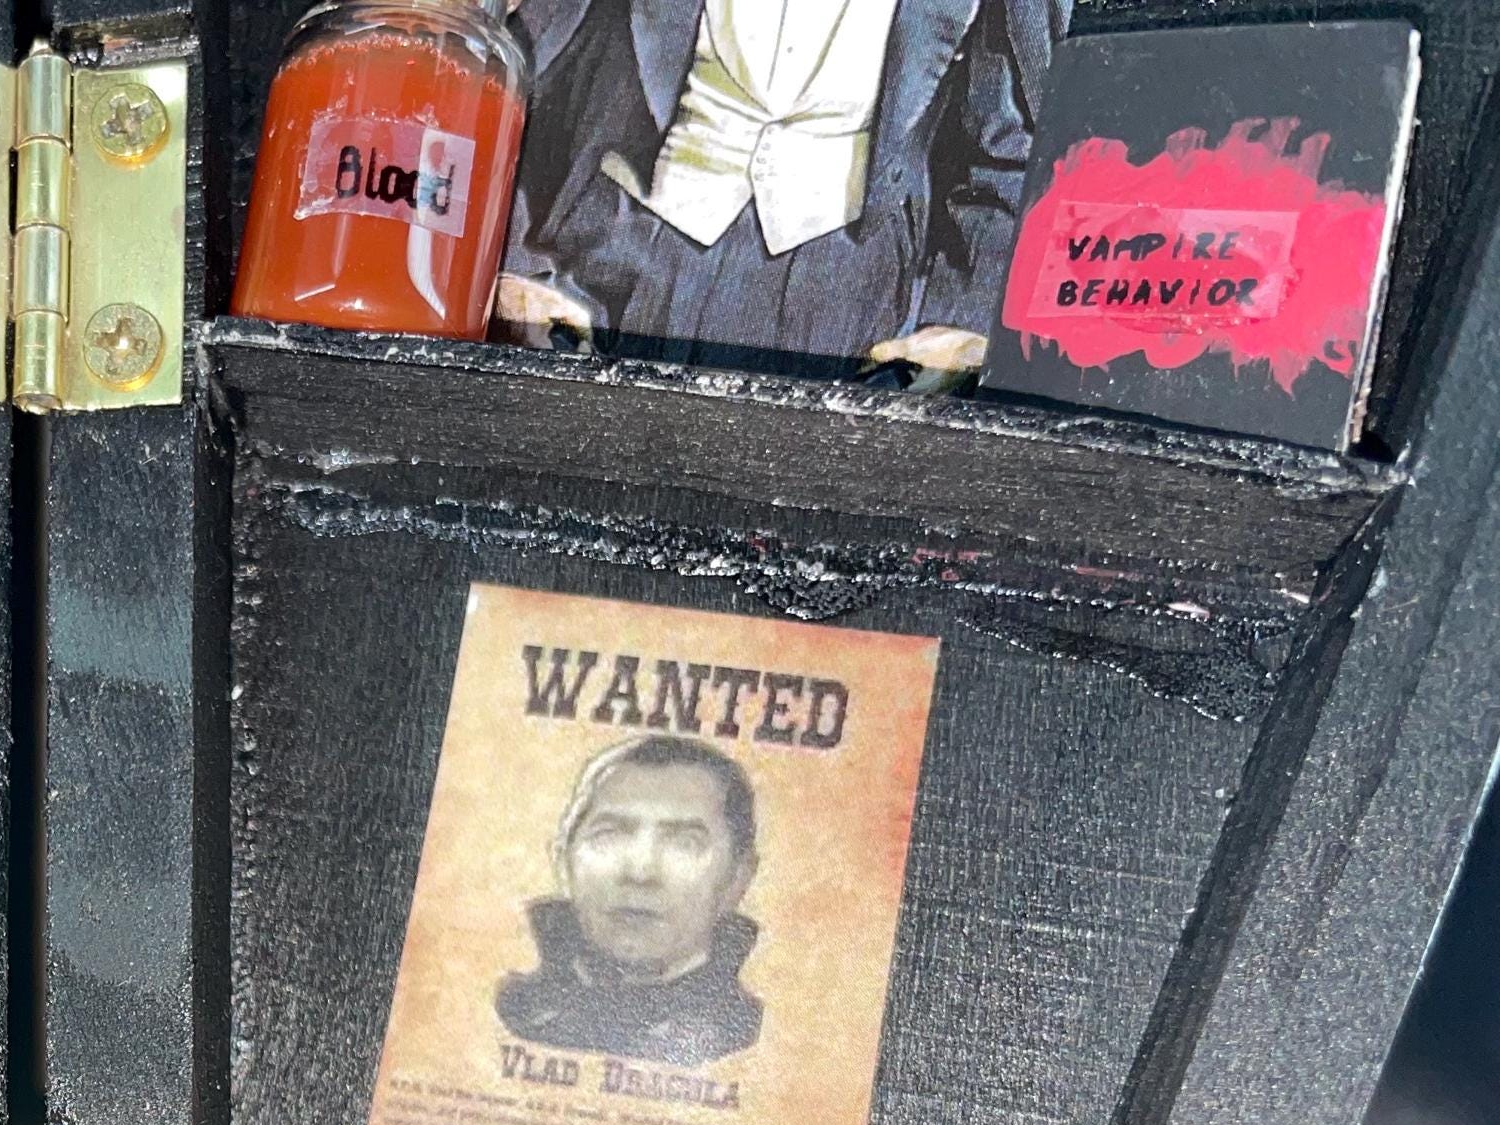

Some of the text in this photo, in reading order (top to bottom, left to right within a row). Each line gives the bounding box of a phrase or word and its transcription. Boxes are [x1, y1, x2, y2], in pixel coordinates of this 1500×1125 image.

[336, 145, 456, 216] Blood
[1067, 232, 1240, 262] VAMPIRE
[1056, 278, 1258, 307] BEHAVIOR
[521, 644, 849, 750] WANTED
